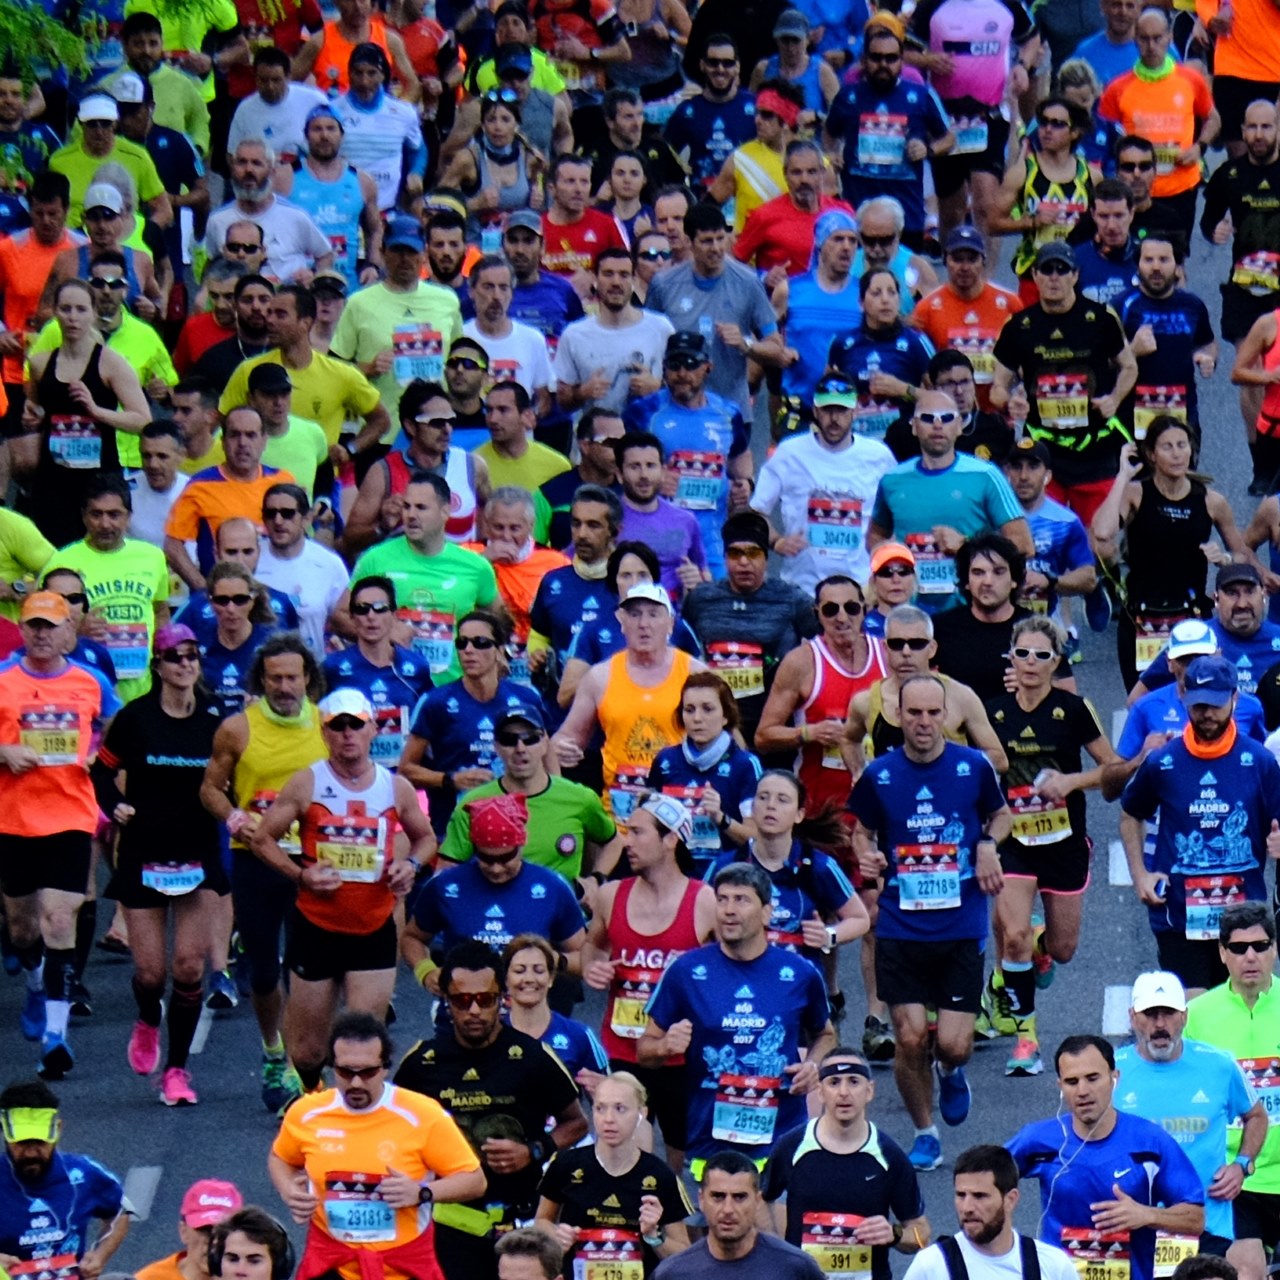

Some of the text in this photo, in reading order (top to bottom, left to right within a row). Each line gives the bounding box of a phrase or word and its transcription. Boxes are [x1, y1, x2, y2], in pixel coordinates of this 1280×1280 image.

[1188, 803, 1229, 813] MADRID
[906, 814, 945, 828] MADRID
[1200, 819, 1219, 829] 2017
[917, 833, 937, 844] 2017
[721, 1017, 766, 1029] MADRID
[733, 1034, 755, 1045] 2017
[830, 1253, 851, 1269] 391
[602, 1261, 623, 1278] 179
